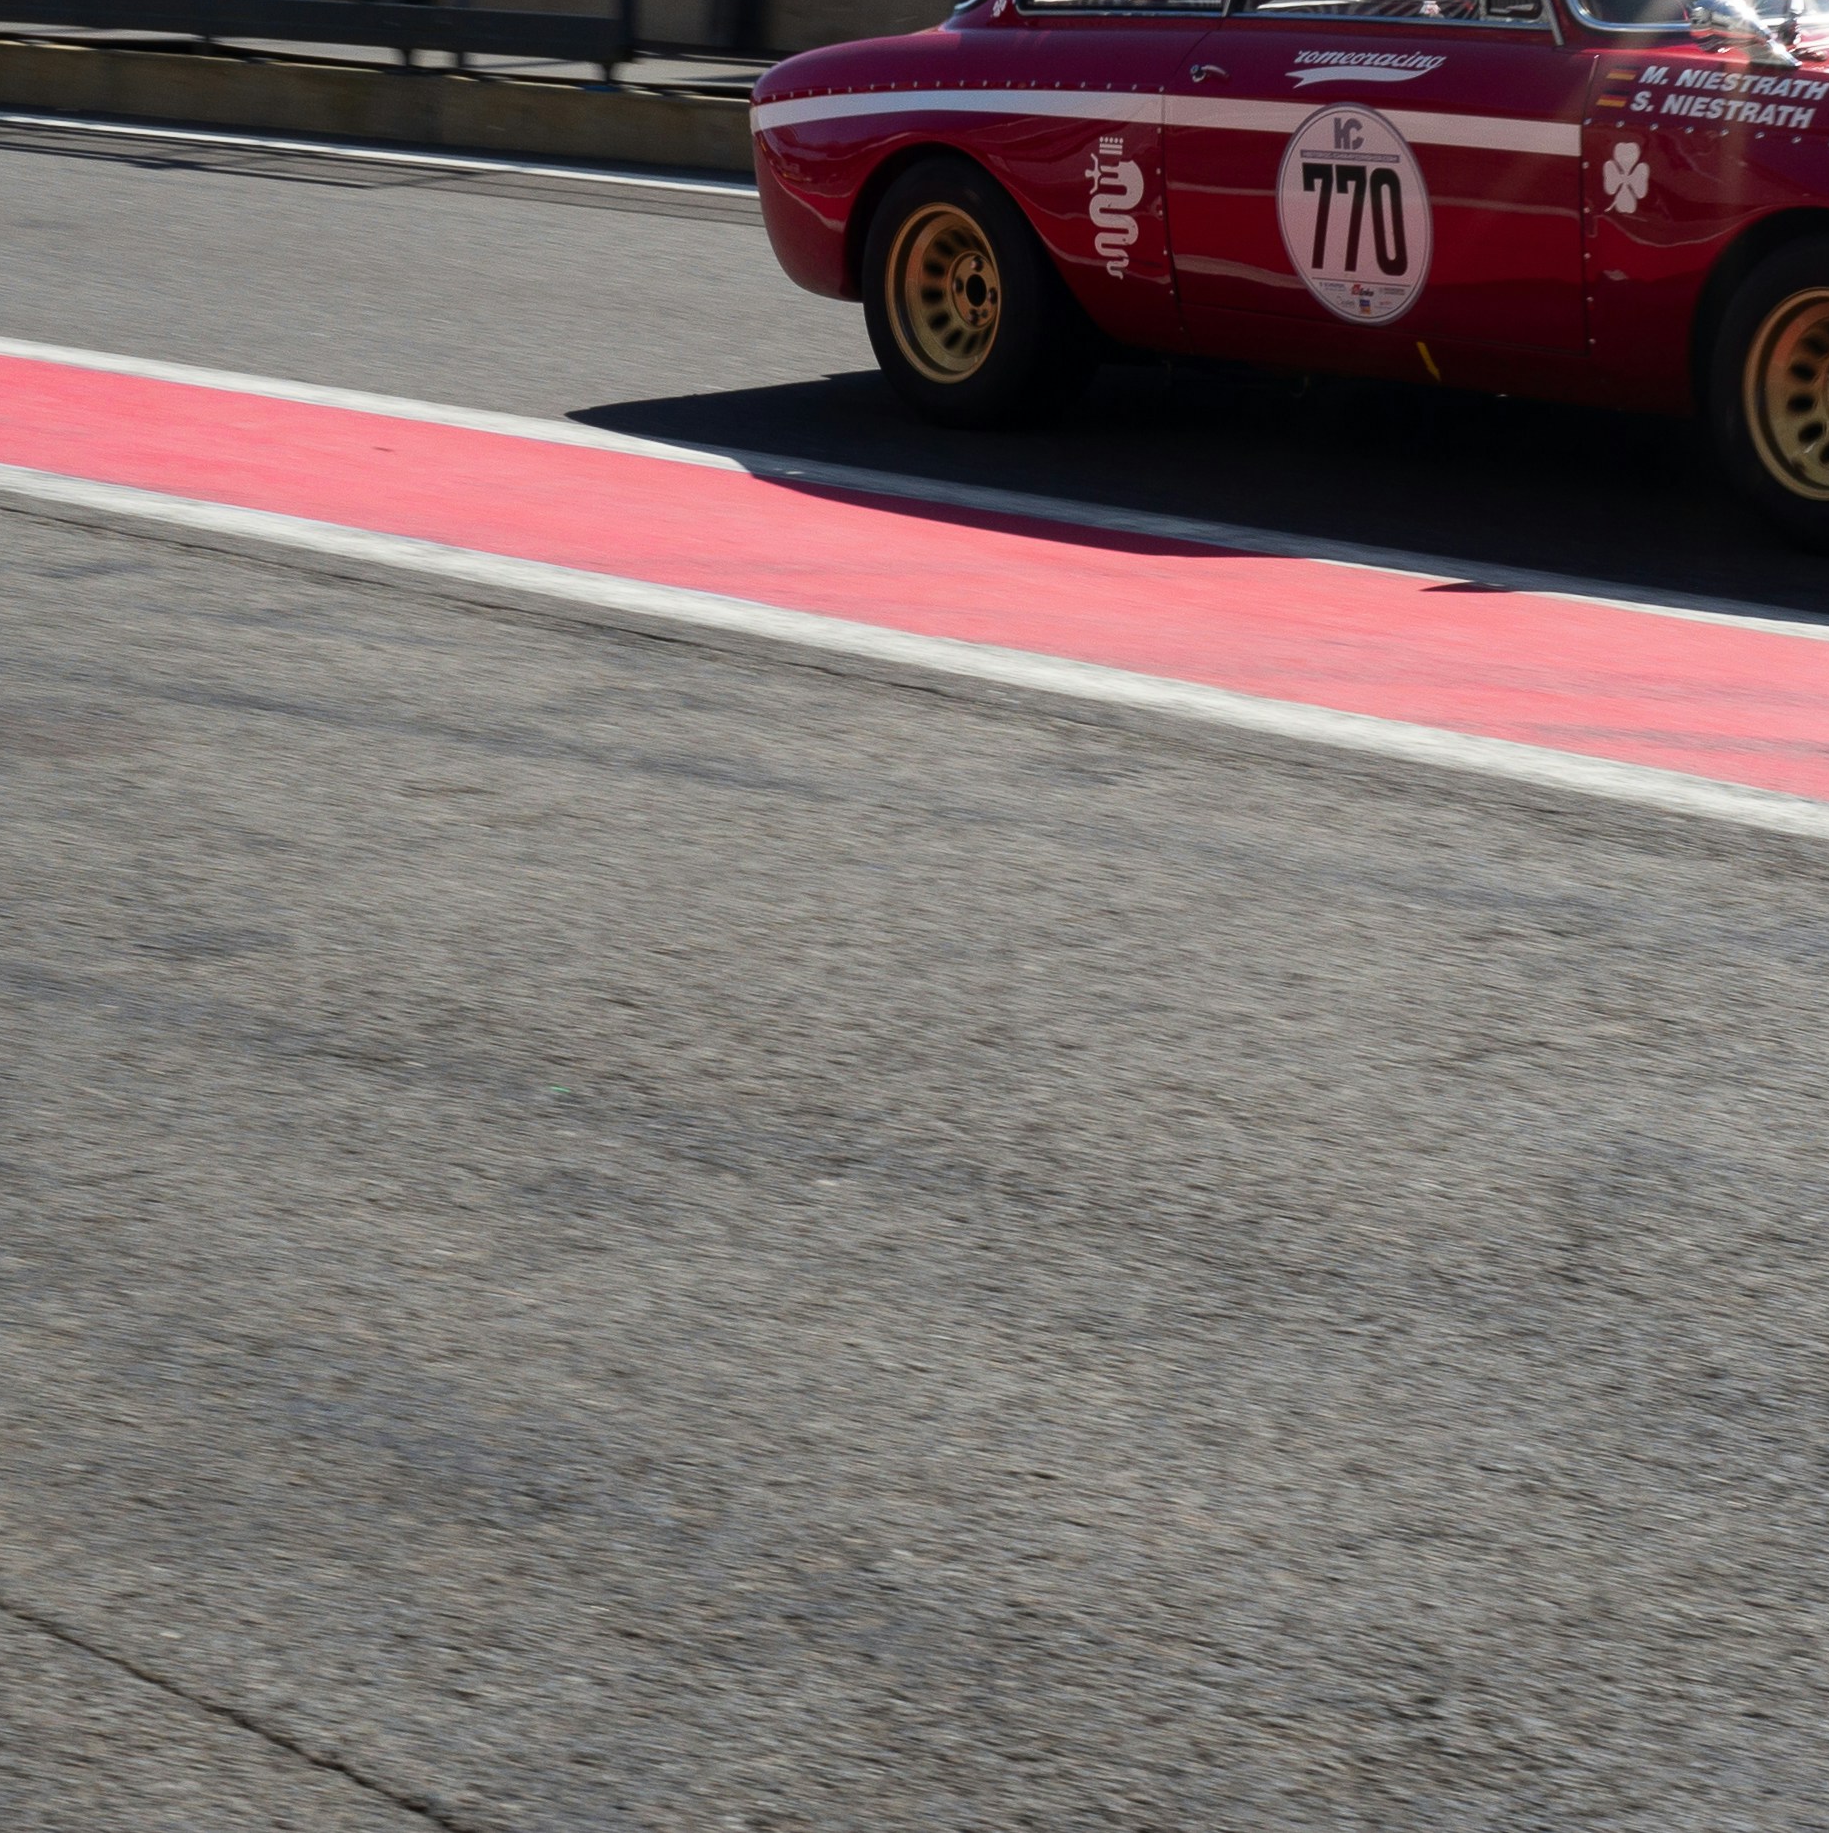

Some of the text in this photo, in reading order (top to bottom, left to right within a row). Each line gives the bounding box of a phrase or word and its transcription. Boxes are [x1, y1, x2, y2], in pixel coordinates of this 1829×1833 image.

[1294, 50, 1447, 69] romeoracing
[1639, 65, 1670, 86] M.
[1630, 90, 1817, 130] S. NIESTRATH
[1302, 162, 1408, 276] 770
